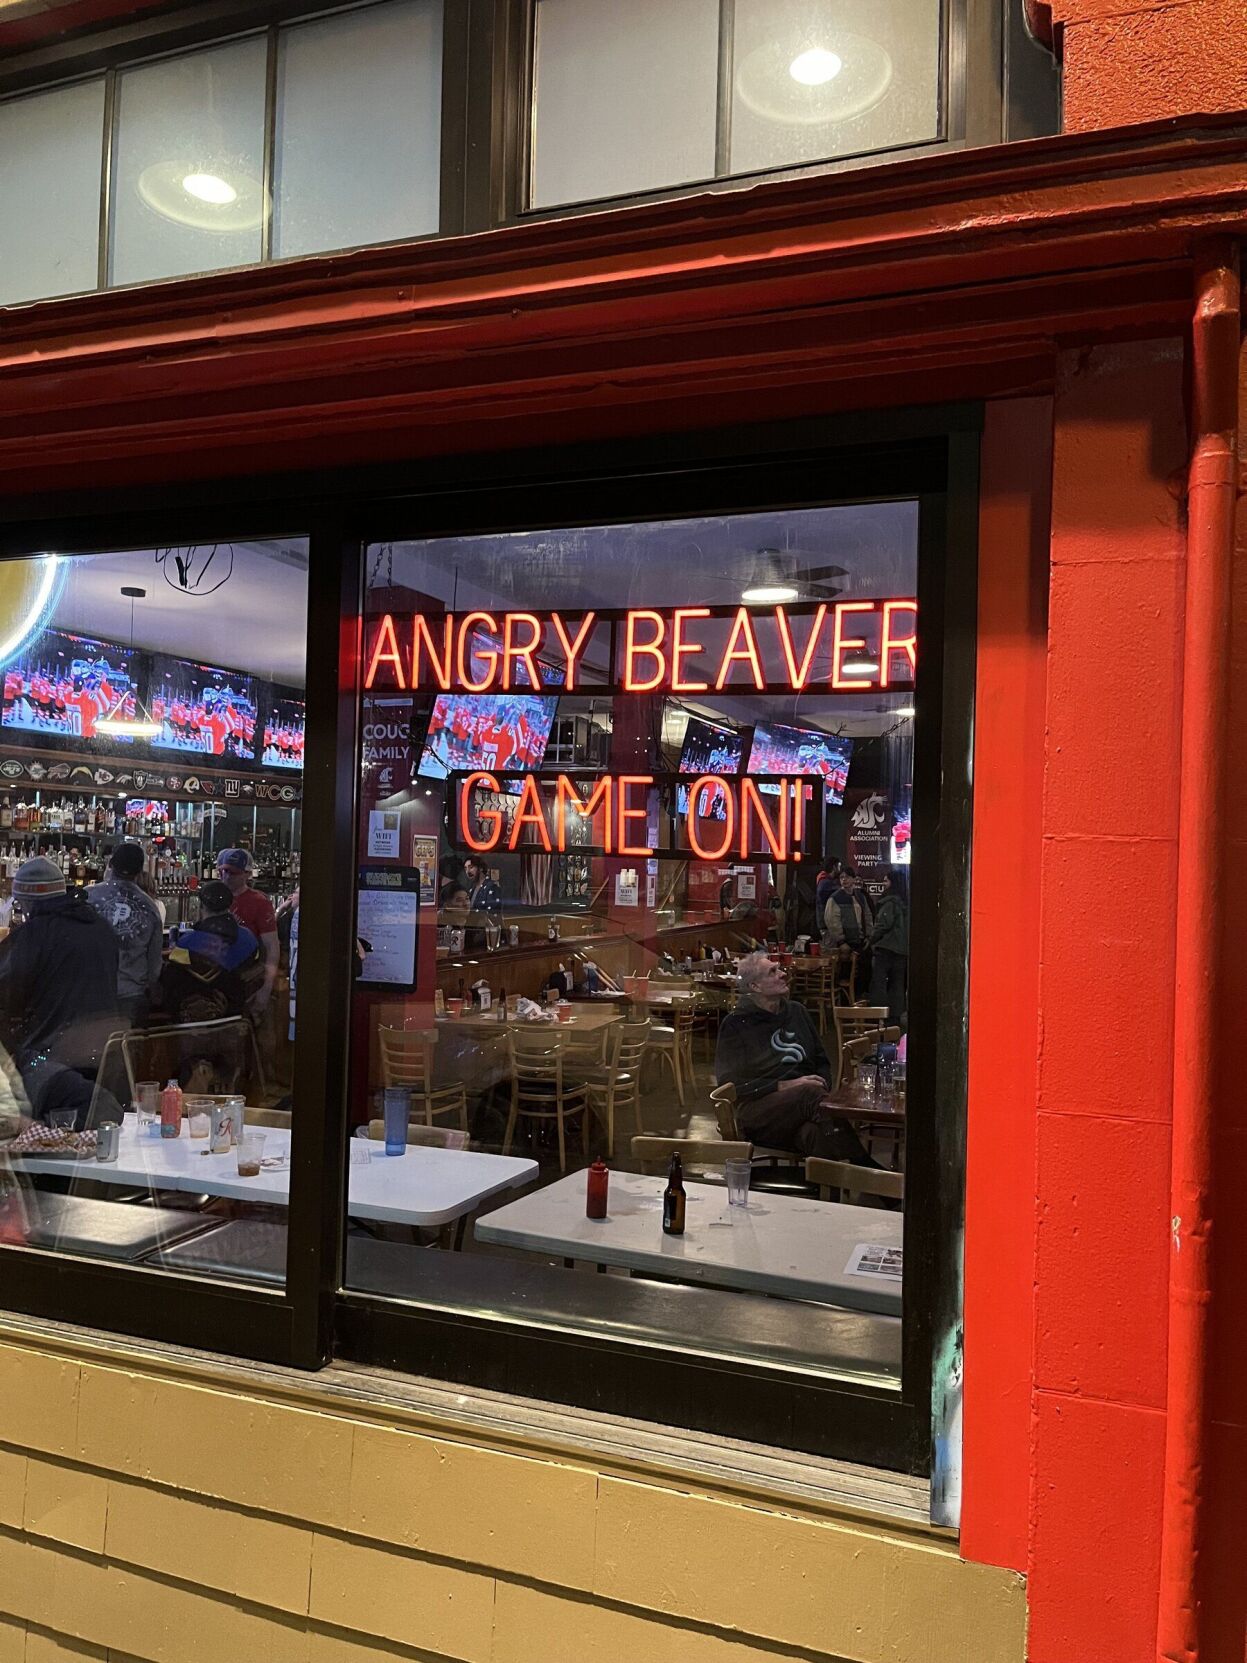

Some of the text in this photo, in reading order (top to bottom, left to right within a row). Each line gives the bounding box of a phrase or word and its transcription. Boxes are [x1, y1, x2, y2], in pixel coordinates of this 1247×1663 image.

[365, 602, 917, 692] ANGRY BEAVER
[363, 723, 410, 740] COUG
[363, 746, 410, 760] FAMILY
[460, 771, 802, 862] GAME ON!
